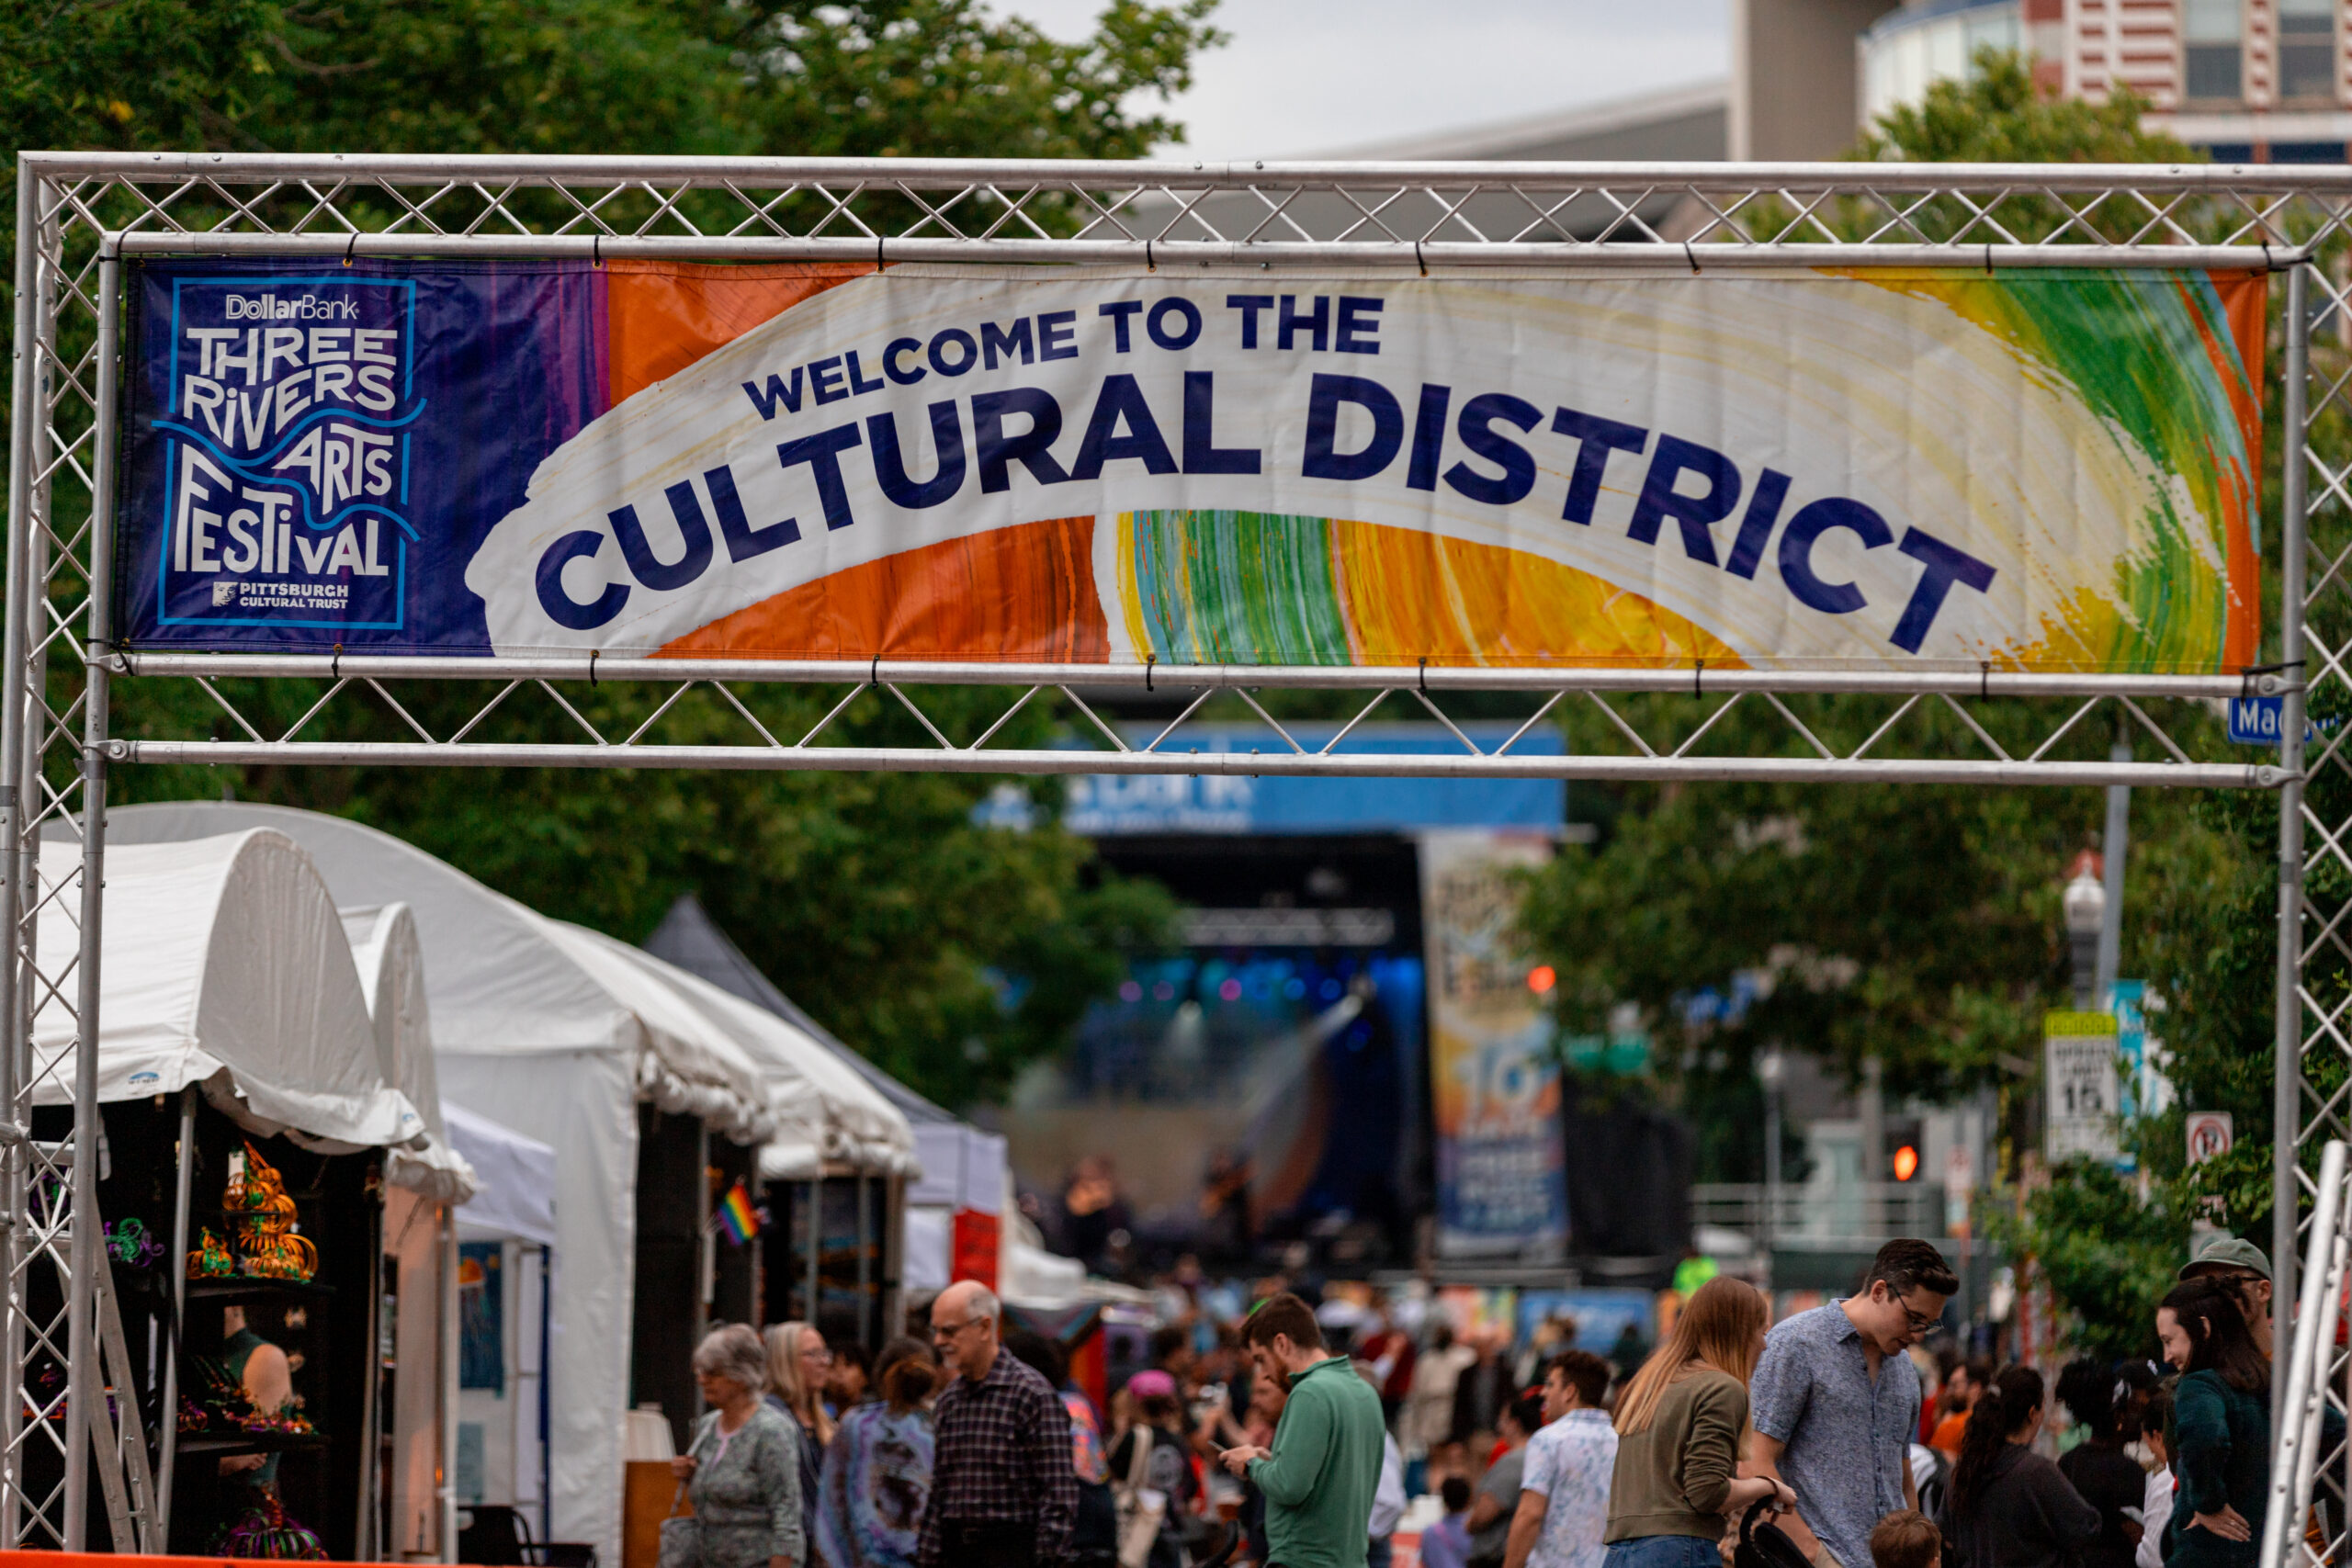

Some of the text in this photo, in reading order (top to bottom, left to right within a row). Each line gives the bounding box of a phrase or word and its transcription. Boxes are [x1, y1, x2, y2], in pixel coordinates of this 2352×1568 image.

[187, 327, 398, 386] THREE
[741, 295, 1385, 423] WELCOME TO THE
[271, 423, 394, 515] ARTS
[536, 369, 1997, 655] CULTURAL DISTRICT
[240, 582, 349, 597] PITTSBURGH
[240, 597, 348, 609] CULTURAL TRUST
[2064, 1083, 2102, 1115] 15
